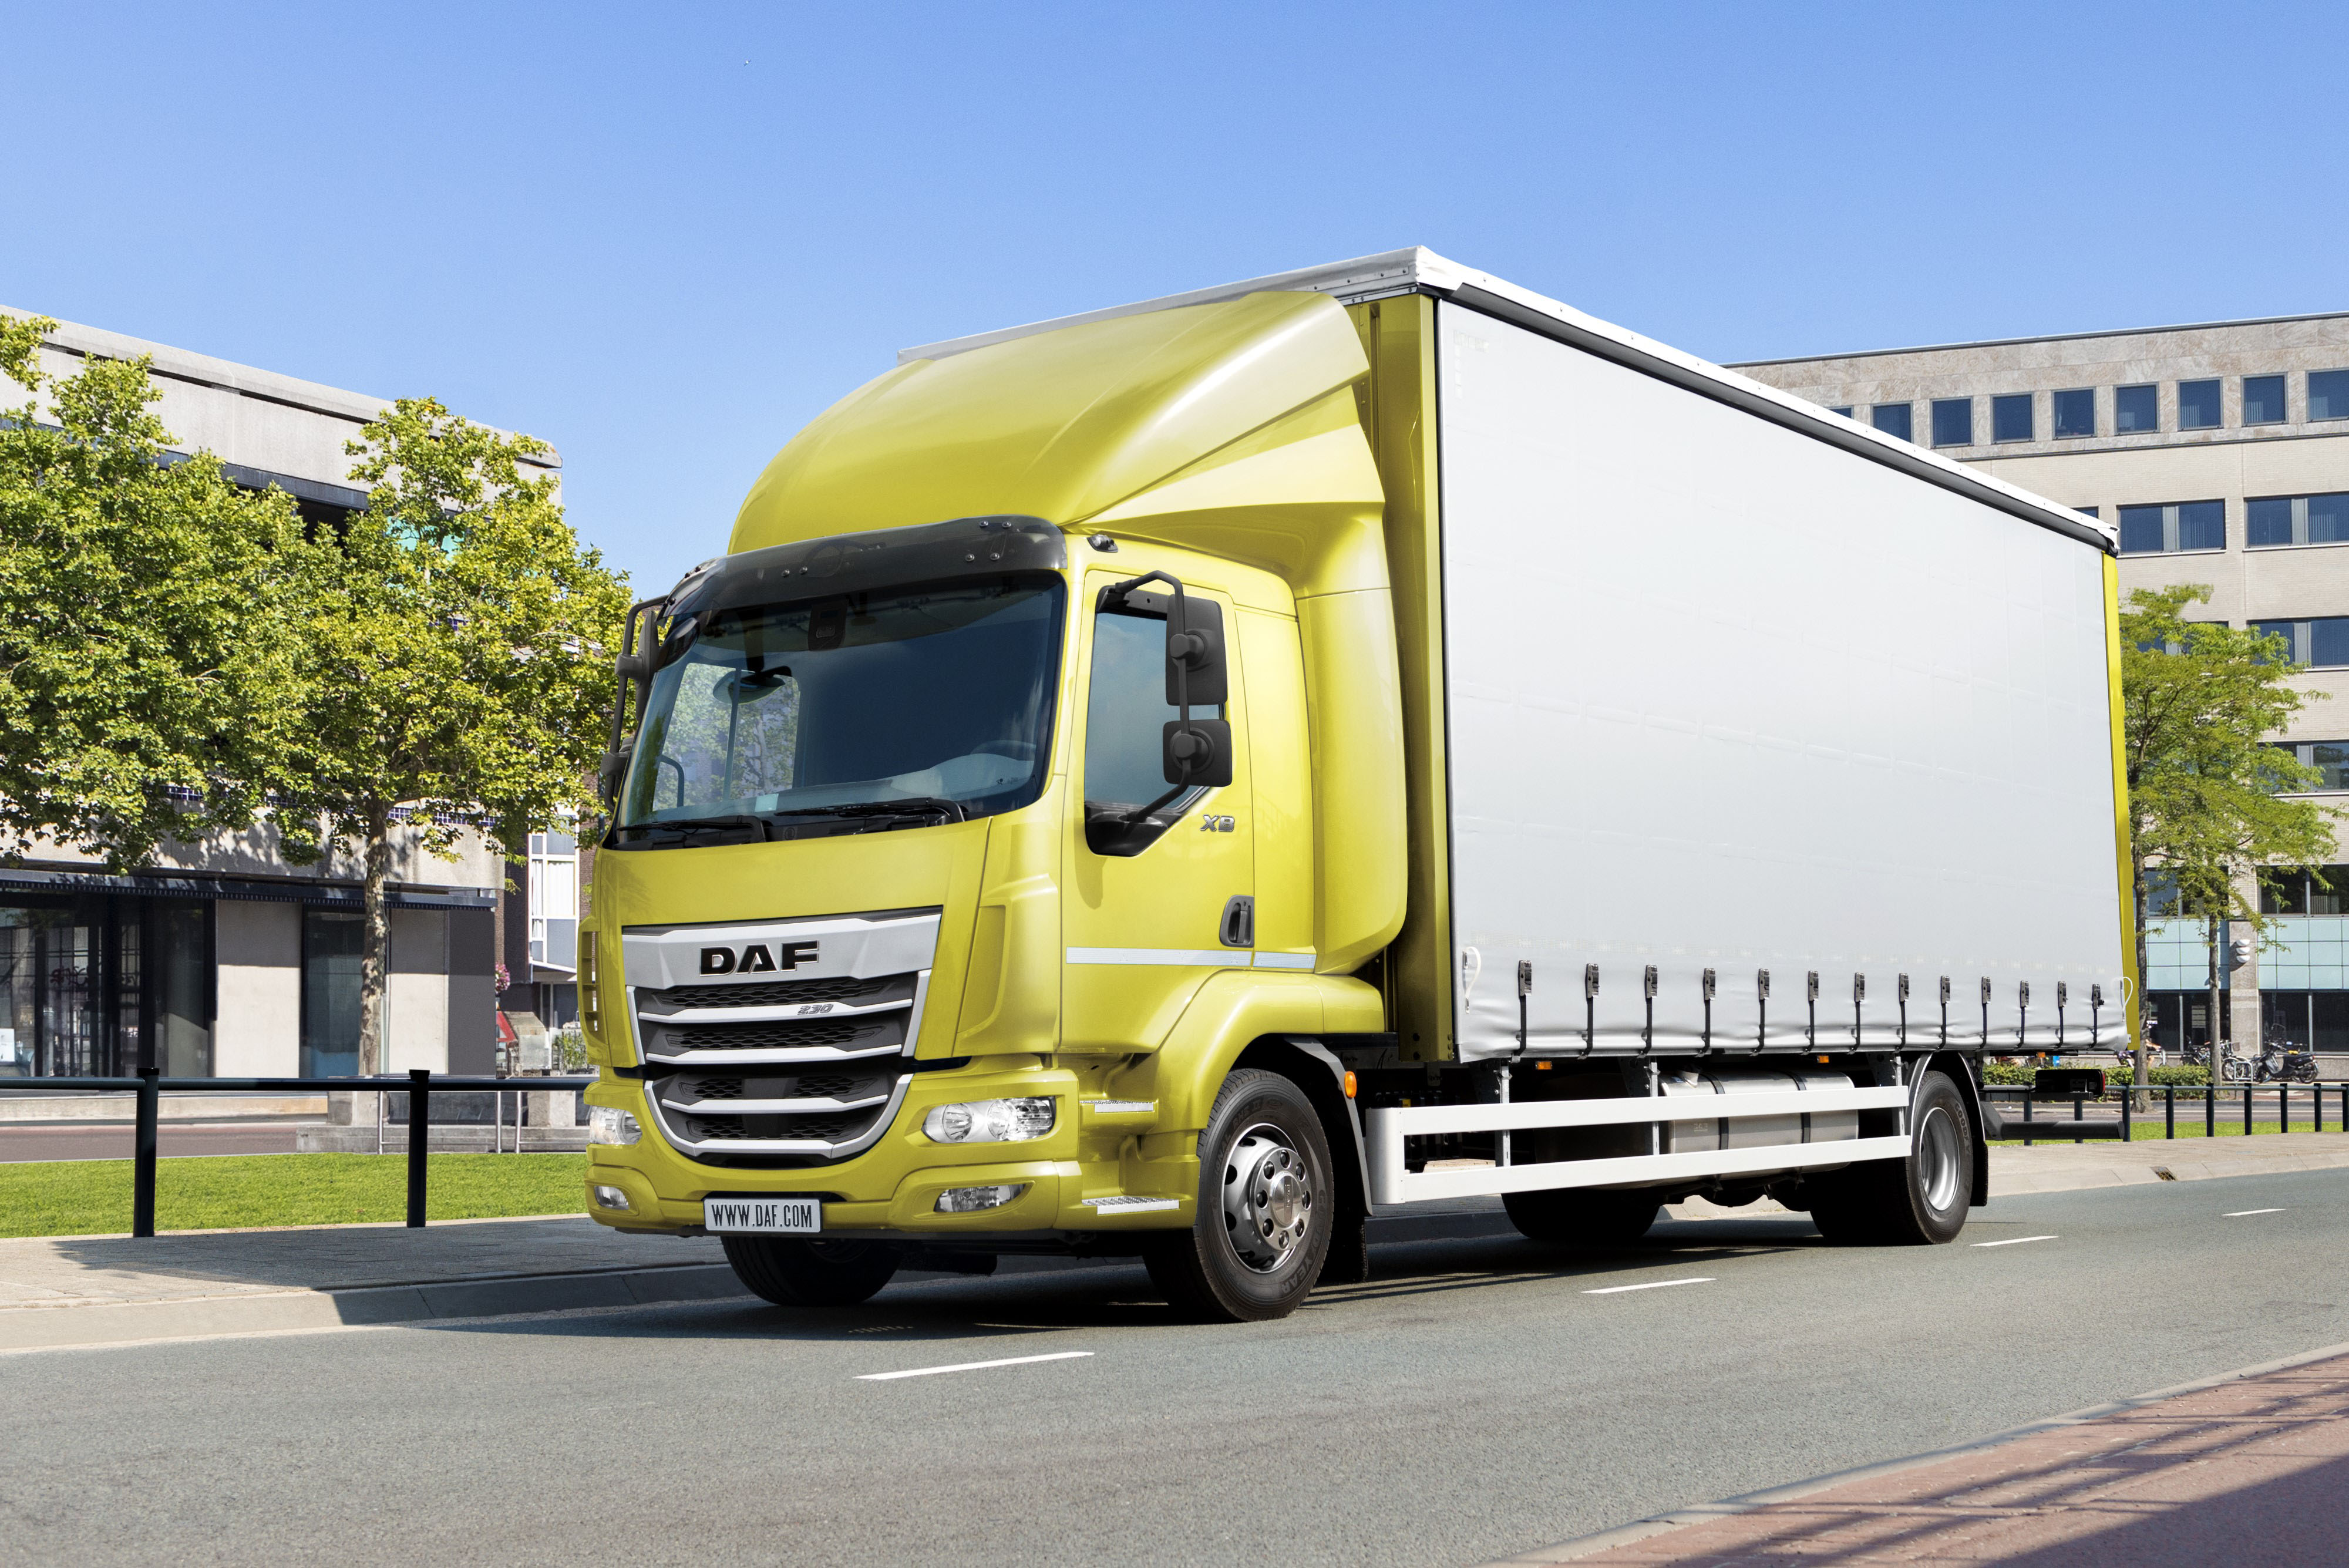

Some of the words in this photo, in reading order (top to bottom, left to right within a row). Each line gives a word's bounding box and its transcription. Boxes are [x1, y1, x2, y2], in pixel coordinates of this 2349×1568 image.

[1200, 815, 1235, 832] XB
[699, 940, 819, 977] DAF
[797, 1004, 834, 1015] 230
[711, 1204, 812, 1228] WWW.DAF.COM
